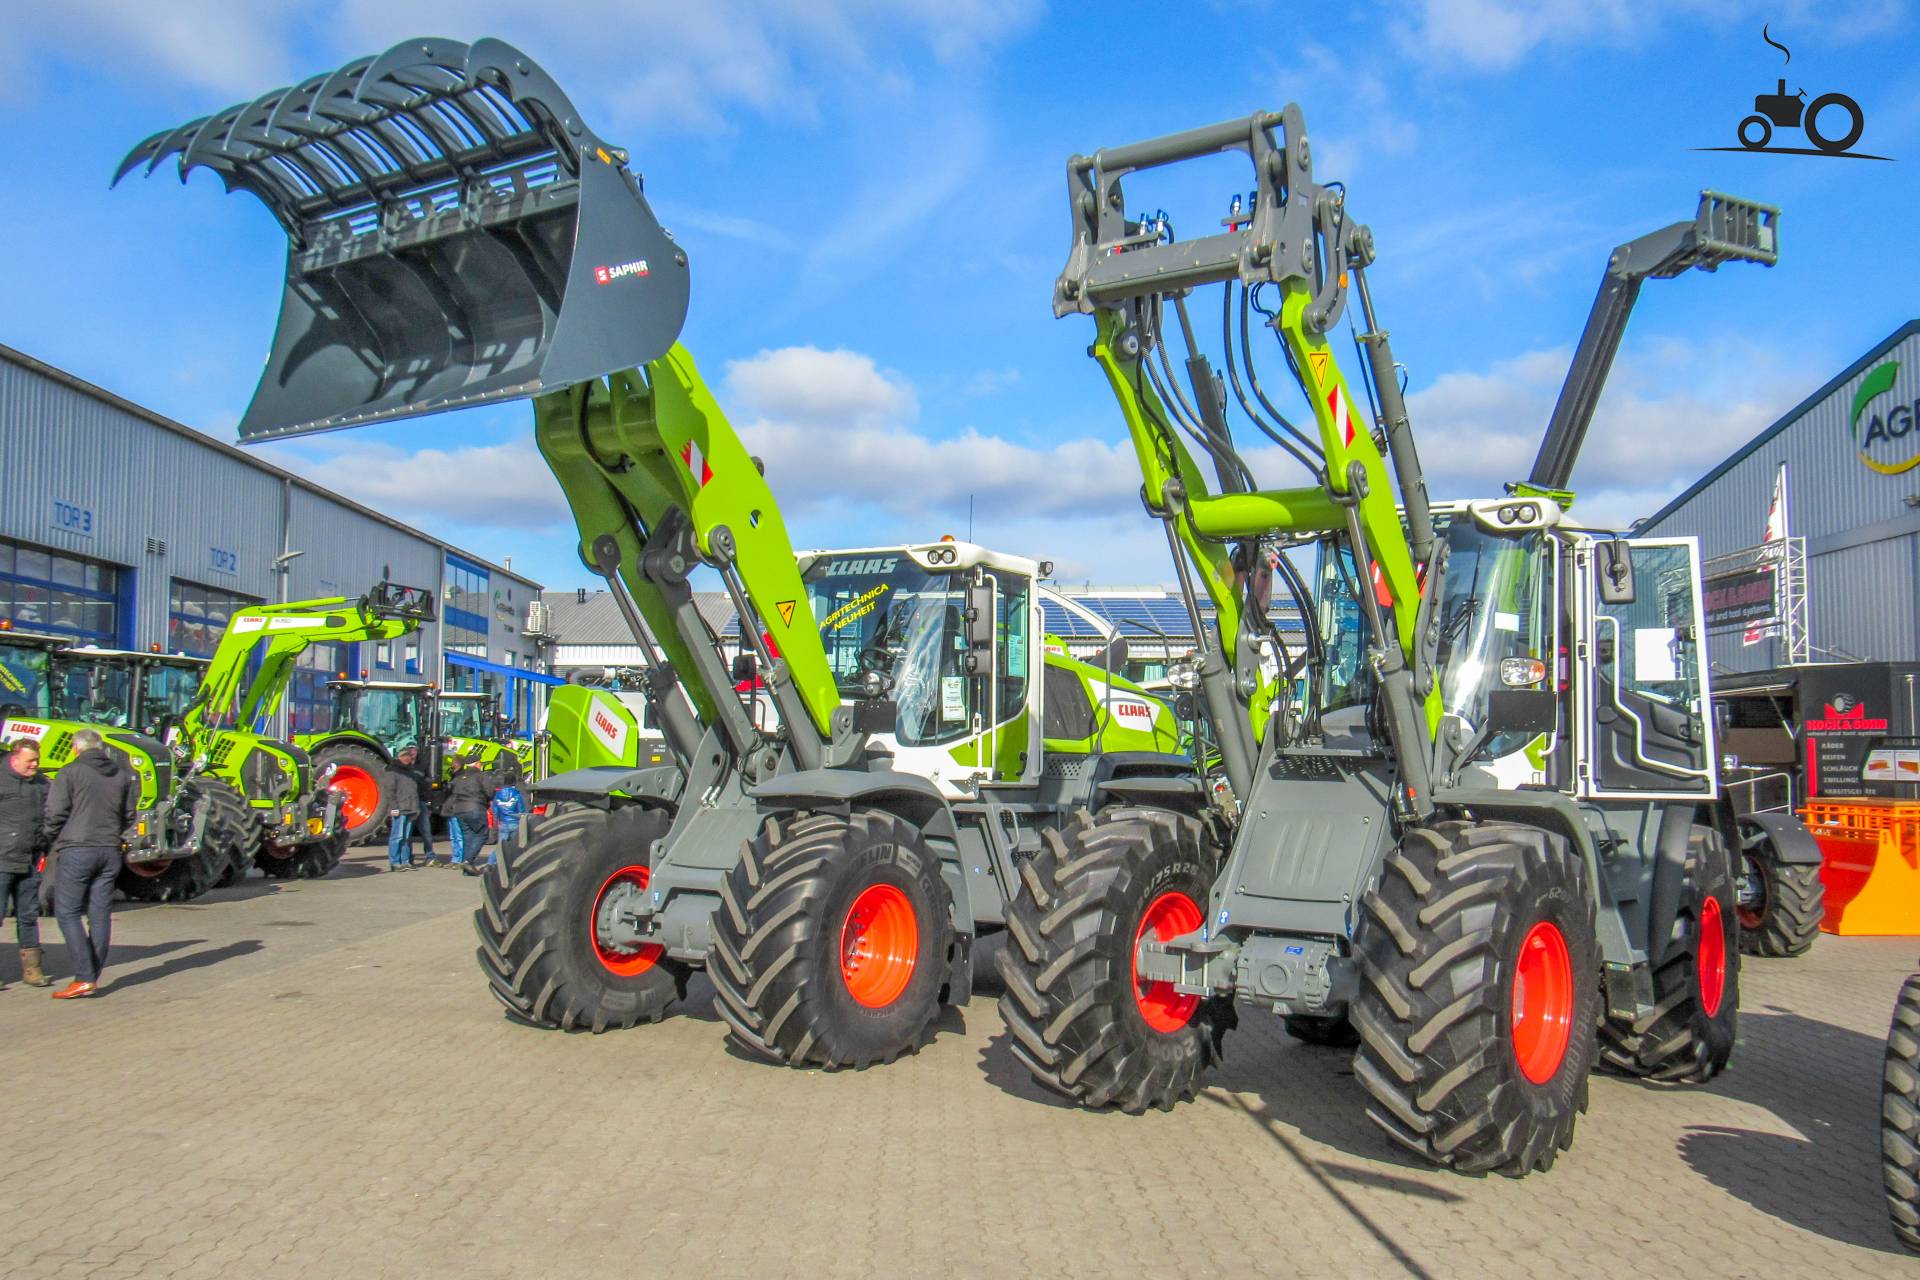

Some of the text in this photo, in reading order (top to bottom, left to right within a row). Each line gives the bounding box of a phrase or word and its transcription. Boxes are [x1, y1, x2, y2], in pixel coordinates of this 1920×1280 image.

[609, 260, 649, 279] SAPHIR
[54, 502, 92, 532] TOR 3
[209, 547, 237, 571] TOR 2
[826, 558, 899, 576] CLAAS
[819, 583, 889, 630] AGRITECHNICA
[832, 601, 876, 632] NEUHEIT
[1118, 704, 1151, 717] CLAAS
[10, 723, 42, 735] CLAAS
[594, 711, 618, 740] CLAAS
